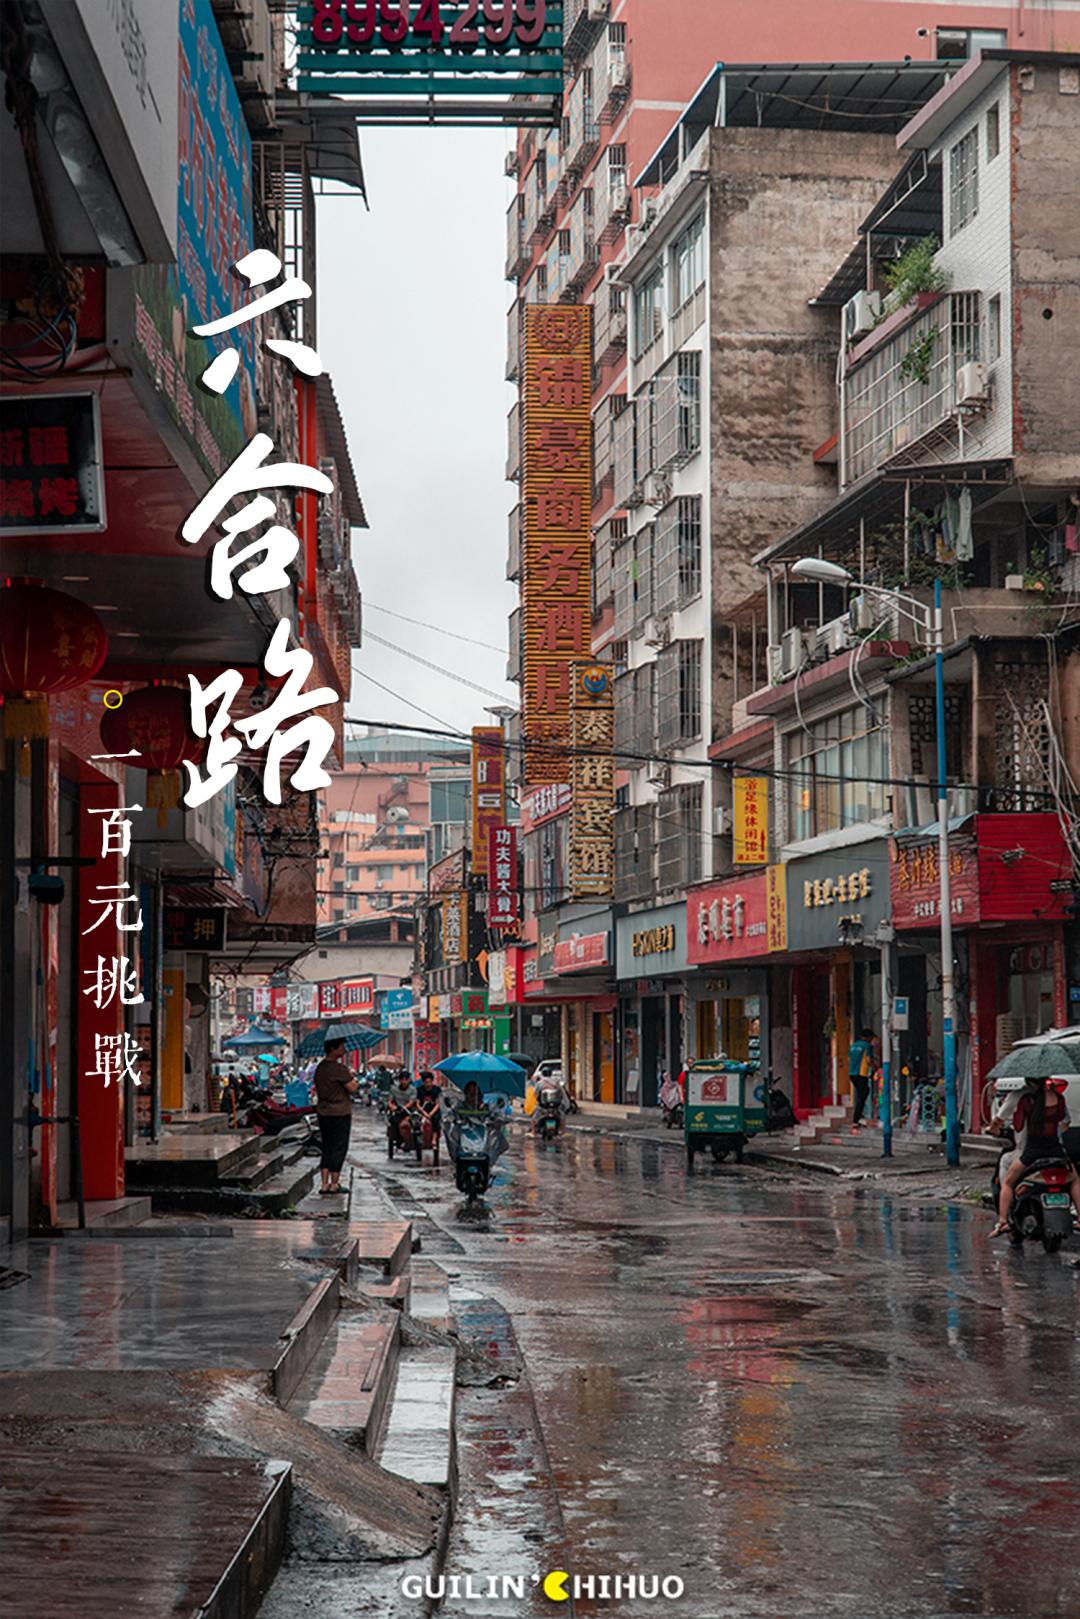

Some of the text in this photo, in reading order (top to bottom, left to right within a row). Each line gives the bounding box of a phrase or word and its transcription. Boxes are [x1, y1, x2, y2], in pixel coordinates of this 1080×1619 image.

[311, 0, 548, 44] 8994299
[534, 356, 584, 714] 锦豪商务酒店
[578, 711, 612, 874] 泰祥宾馆
